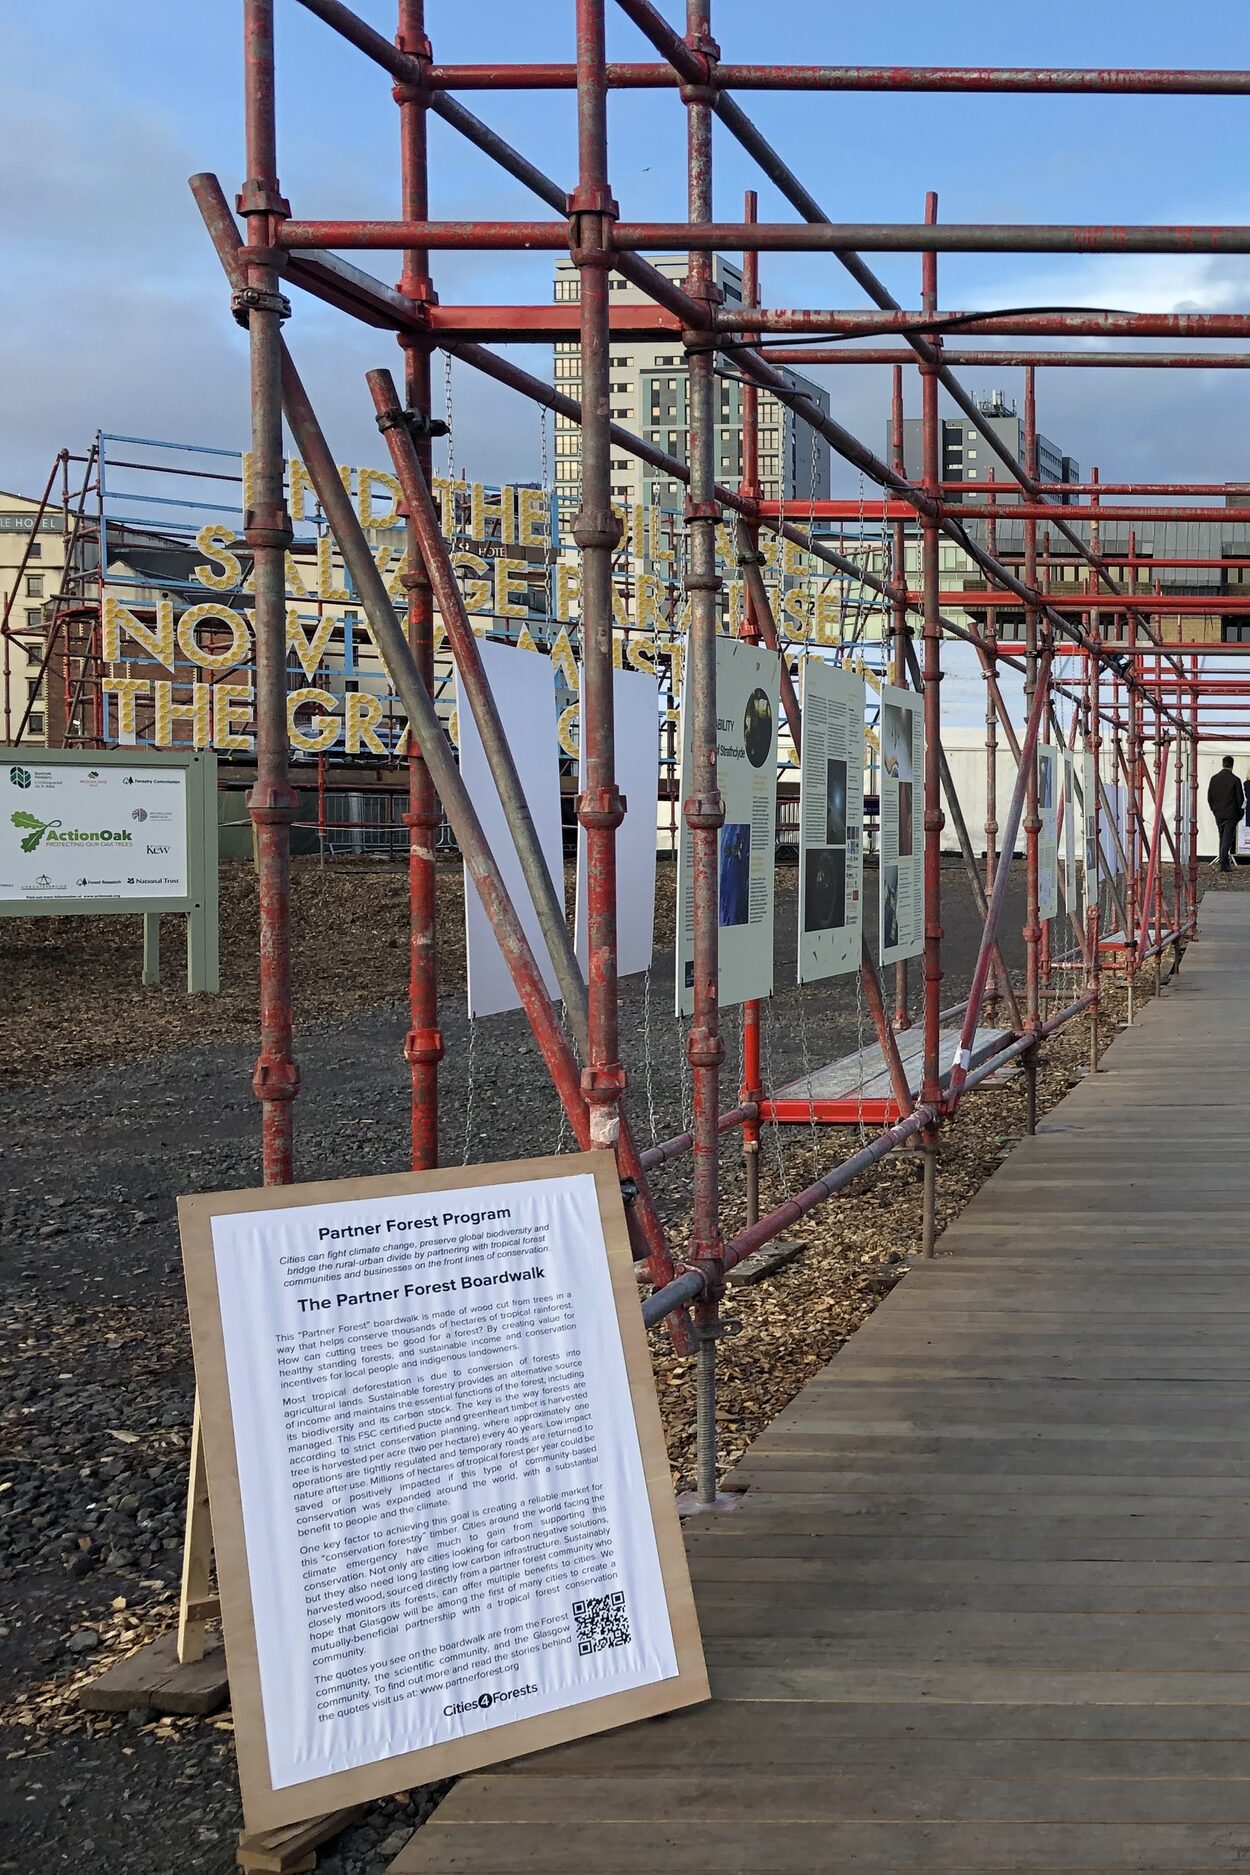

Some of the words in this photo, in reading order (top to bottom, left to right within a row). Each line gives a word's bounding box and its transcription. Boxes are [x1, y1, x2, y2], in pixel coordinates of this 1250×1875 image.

[431, 476, 551, 547] THE
[102, 596, 337, 683] NOW
[102, 677, 255, 750] THE
[46, 829, 132, 841] ActionOak
[279, 1256, 306, 1265] Cities
[308, 1253, 325, 1261] can
[327, 1249, 347, 1260] fight
[348, 1246, 381, 1256] climate
[419, 1237, 457, 1249] preserve
[458, 1232, 484, 1244] global
[486, 1227, 532, 1238] biodiversity
[534, 1223, 549, 1233] and
[318, 1224, 381, 1241] Partner
[386, 1216, 439, 1232] Forest
[442, 1209, 511, 1225] Program
[283, 1274, 342, 1287] communities
[344, 1269, 361, 1279] and
[363, 1264, 413, 1276] businesses
[414, 1262, 426, 1270] on
[428, 1260, 442, 1268] the
[443, 1256, 463, 1266] front
[465, 1255, 485, 1263] lines
[486, 1251, 495, 1260] of
[287, 1266, 316, 1275] bridge
[318, 1263, 333, 1271] the
[335, 1257, 384, 1269] rural-urban
[386, 1252, 412, 1262] divide
[414, 1251, 425, 1260] by
[427, 1246, 470, 1259] partnering
[472, 1242, 488, 1251] with
[491, 1238, 521, 1249] tropical
[522, 1235, 545, 1244] forest
[297, 1298, 331, 1312] The
[336, 1289, 399, 1307] Partner
[404, 1279, 457, 1297] Forest
[461, 1266, 545, 1289] Boardwalk
[275, 1334, 295, 1342] This
[373, 1314, 419, 1328] boardwalk
[432, 1309, 456, 1319] made
[458, 1306, 467, 1315] of
[470, 1303, 493, 1313] wood
[496, 1301, 509, 1309] cut
[276, 1346, 295, 1354] way
[298, 1341, 316, 1351] that
[319, 1338, 344, 1347] helps
[347, 1331, 388, 1343] conserve
[391, 1323, 436, 1336] thousands
[439, 1320, 448, 1329] of
[450, 1316, 487, 1327] hectares
[489, 1313, 498, 1321] of
[500, 1308, 531, 1319] tropical
[278, 1357, 300, 1366] How
[304, 1353, 321, 1362] can
[325, 1348, 356, 1358] cutting
[360, 1344, 383, 1352] trees
[403, 1335, 426, 1347] good
[454, 1326, 483, 1337] forest?
[487, 1324, 498, 1333] By
[502, 1320, 535, 1330] creating
[538, 1316, 560, 1324] value
[279, 1366, 313, 1377] healthy
[318, 1359, 357, 1371] standing
[399, 1348, 415, 1358] and
[419, 1341, 467, 1354] sustainable
[471, 1336, 501, 1346] income
[506, 1331, 522, 1340] and
[525, 1324, 577, 1337] conservation
[280, 1375, 328, 1389] incentives
[330, 1372, 342, 1380] for
[344, 1367, 366, 1378] local
[368, 1363, 399, 1376] people
[402, 1359, 418, 1368] and
[419, 1353, 467, 1366] indigenous
[374, 1685, 386, 1694] To
[388, 1679, 405, 1691] find
[408, 1675, 423, 1685] out
[425, 1669, 450, 1681] more
[452, 1662, 469, 1674] and
[471, 1656, 492, 1669] read
[494, 1654, 508, 1663] the
[511, 1645, 540, 1658] stories
[542, 1635, 572, 1650] behind
[318, 1713, 335, 1722] the
[337, 1703, 370, 1718] quotes
[372, 1696, 391, 1707] visit
[393, 1694, 404, 1702] us
[406, 1690, 418, 1698] at:
[420, 1663, 519, 1695] www.partnerforest.org
